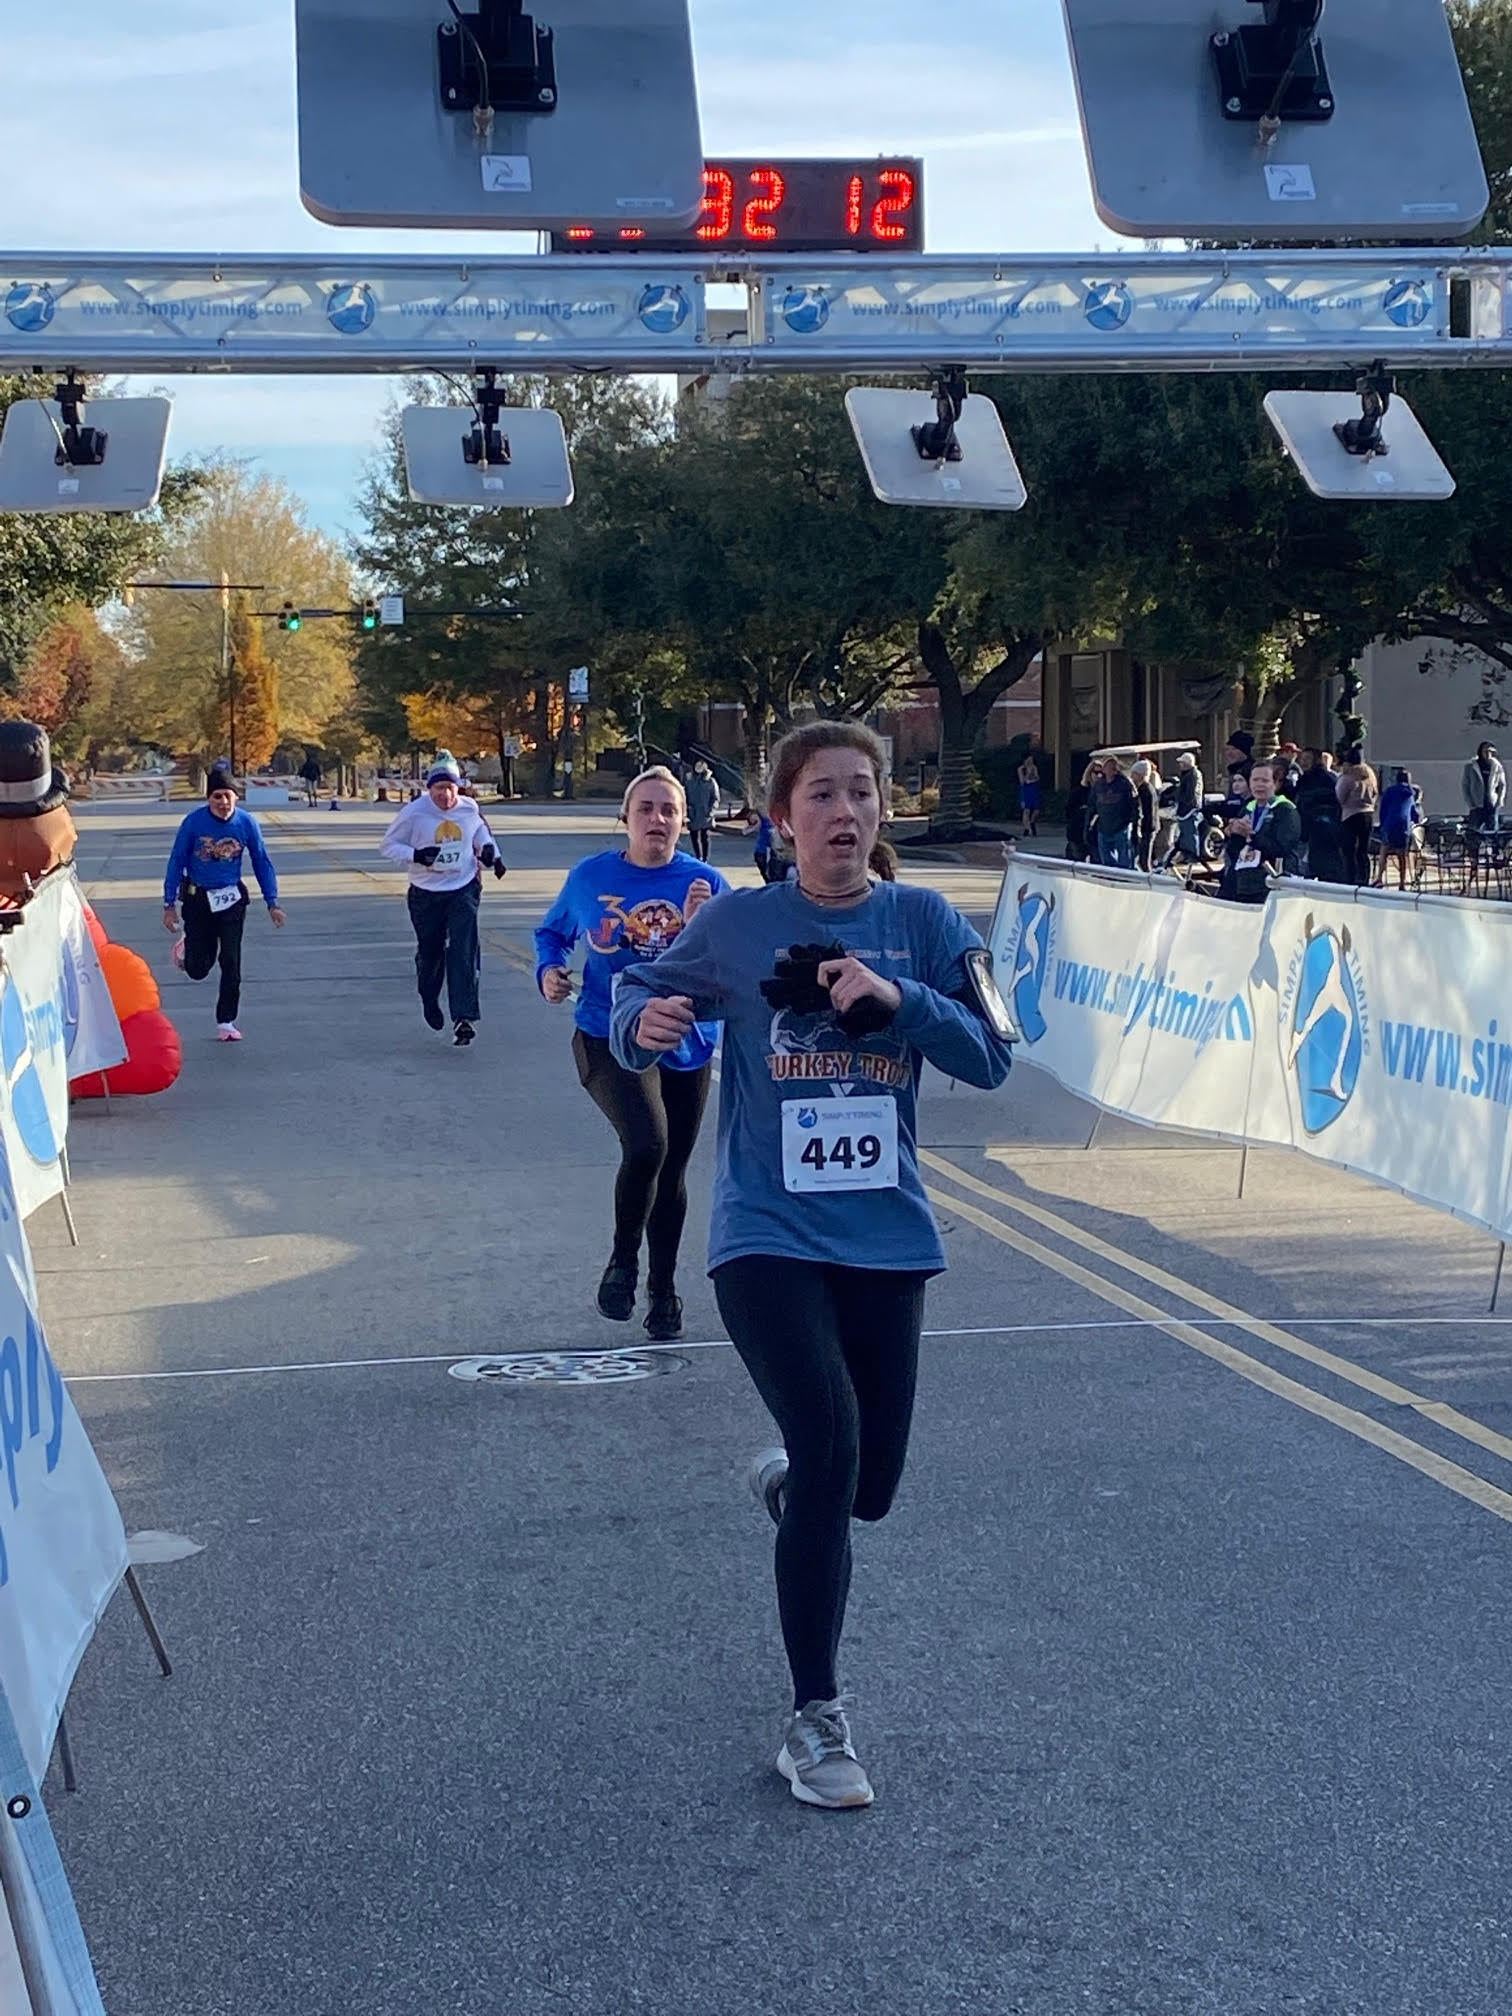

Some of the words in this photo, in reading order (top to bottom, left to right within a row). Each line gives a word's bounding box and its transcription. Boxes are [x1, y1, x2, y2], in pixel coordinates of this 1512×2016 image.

[696, 167, 785, 241] 32
[847, 167, 915, 241] 12
[81, 299, 303, 320] www.simplytiming.com
[400, 298, 616, 320] www.simplytiming.com
[851, 297, 1062, 319] www.simplytiming.com
[1153, 294, 1363, 315] www.simplytiming.com
[1279, 938, 1307, 1025] SIMPLY
[1350, 950, 1372, 1057] TIMING
[800, 1134, 882, 1171] 449
